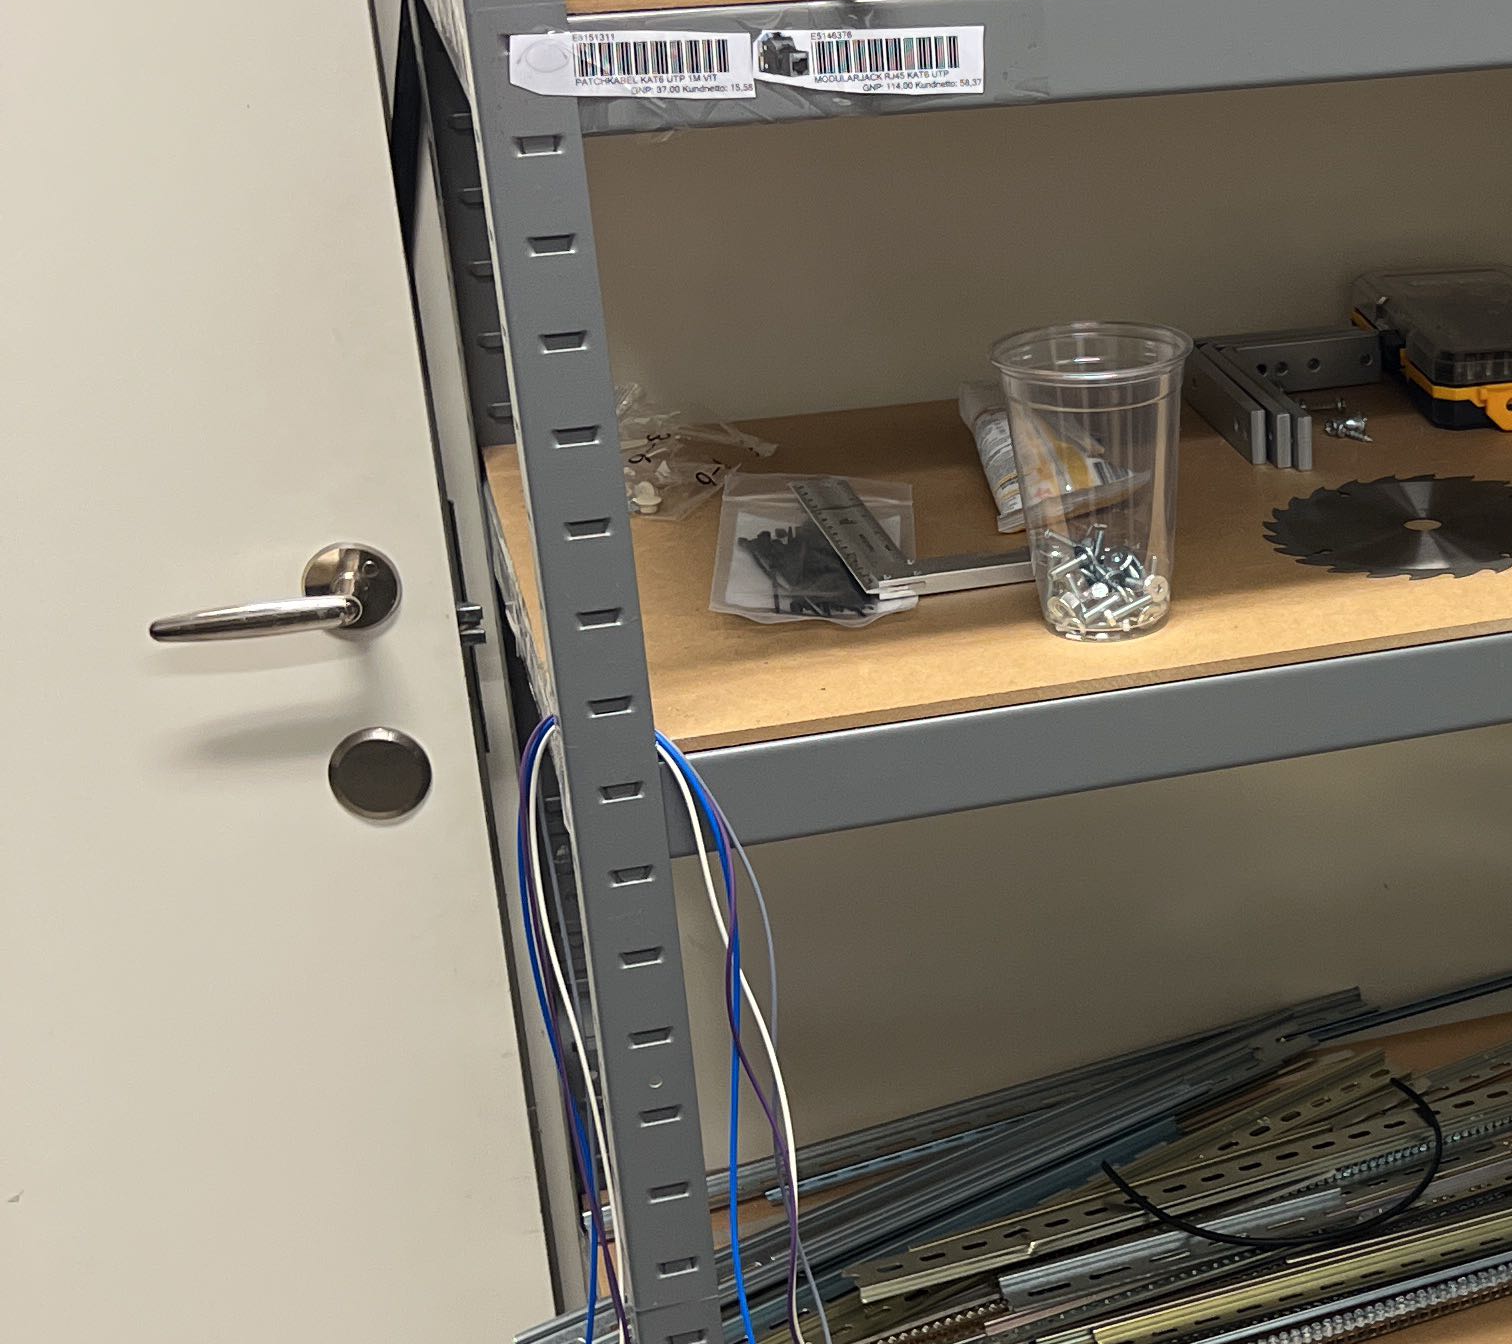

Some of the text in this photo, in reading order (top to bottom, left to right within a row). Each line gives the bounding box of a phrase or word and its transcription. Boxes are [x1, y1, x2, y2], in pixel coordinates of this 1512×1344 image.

[575, 76, 638, 86] PATCHKABEL
[667, 74, 686, 83] UTP
[814, 73, 882, 83] MODULARJACK
[931, 69, 950, 78] UTP
